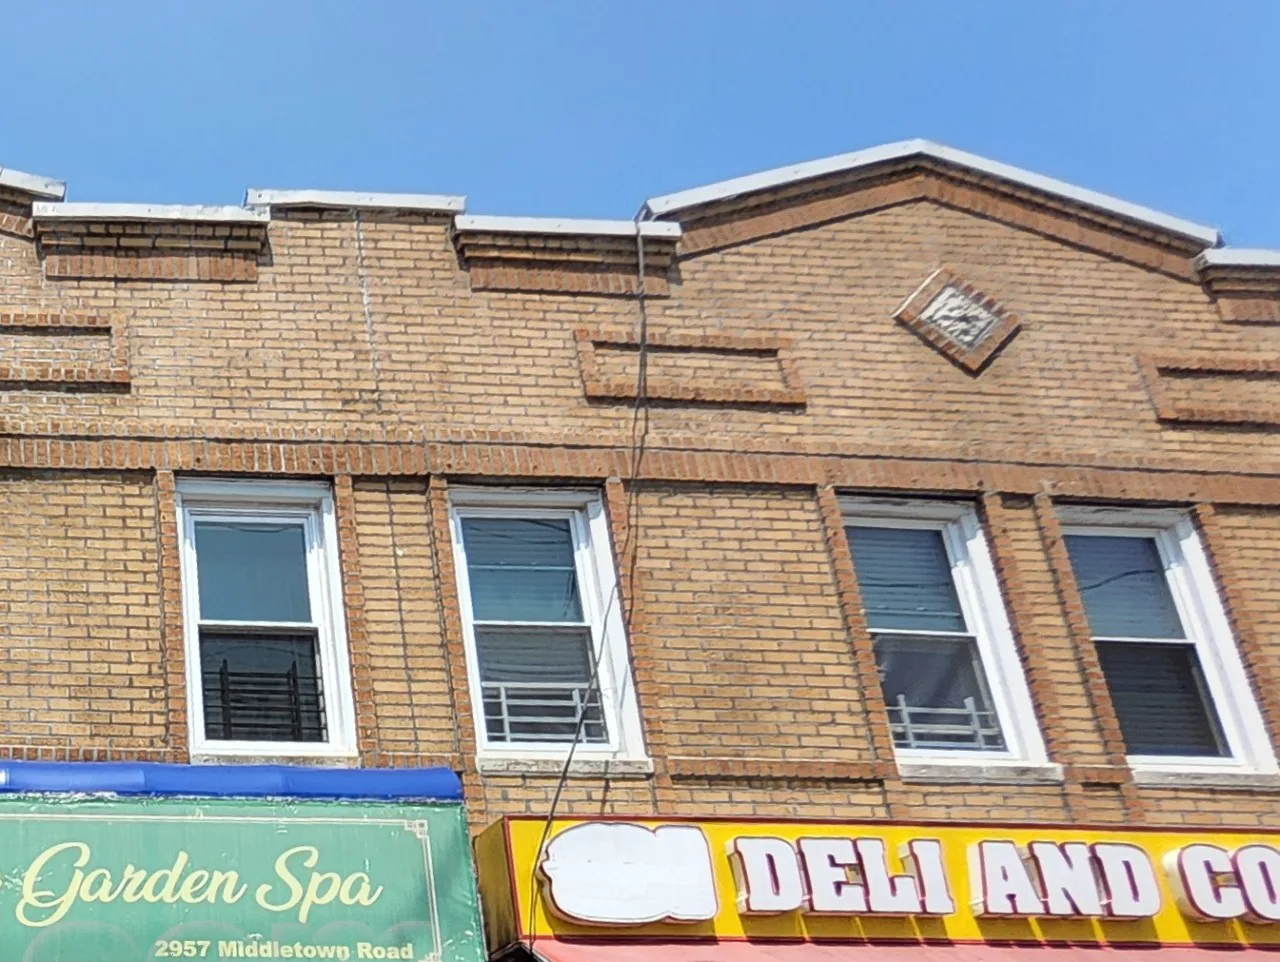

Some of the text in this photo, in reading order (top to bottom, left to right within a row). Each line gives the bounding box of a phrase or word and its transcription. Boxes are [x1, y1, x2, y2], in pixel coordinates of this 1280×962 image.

[15, 841, 248, 928] Garden
[255, 845, 384, 924] Spa
[732, 835, 956, 915] DELI
[975, 839, 1162, 917] AND
[154, 939, 414, 960] 2957 Middletown Road
